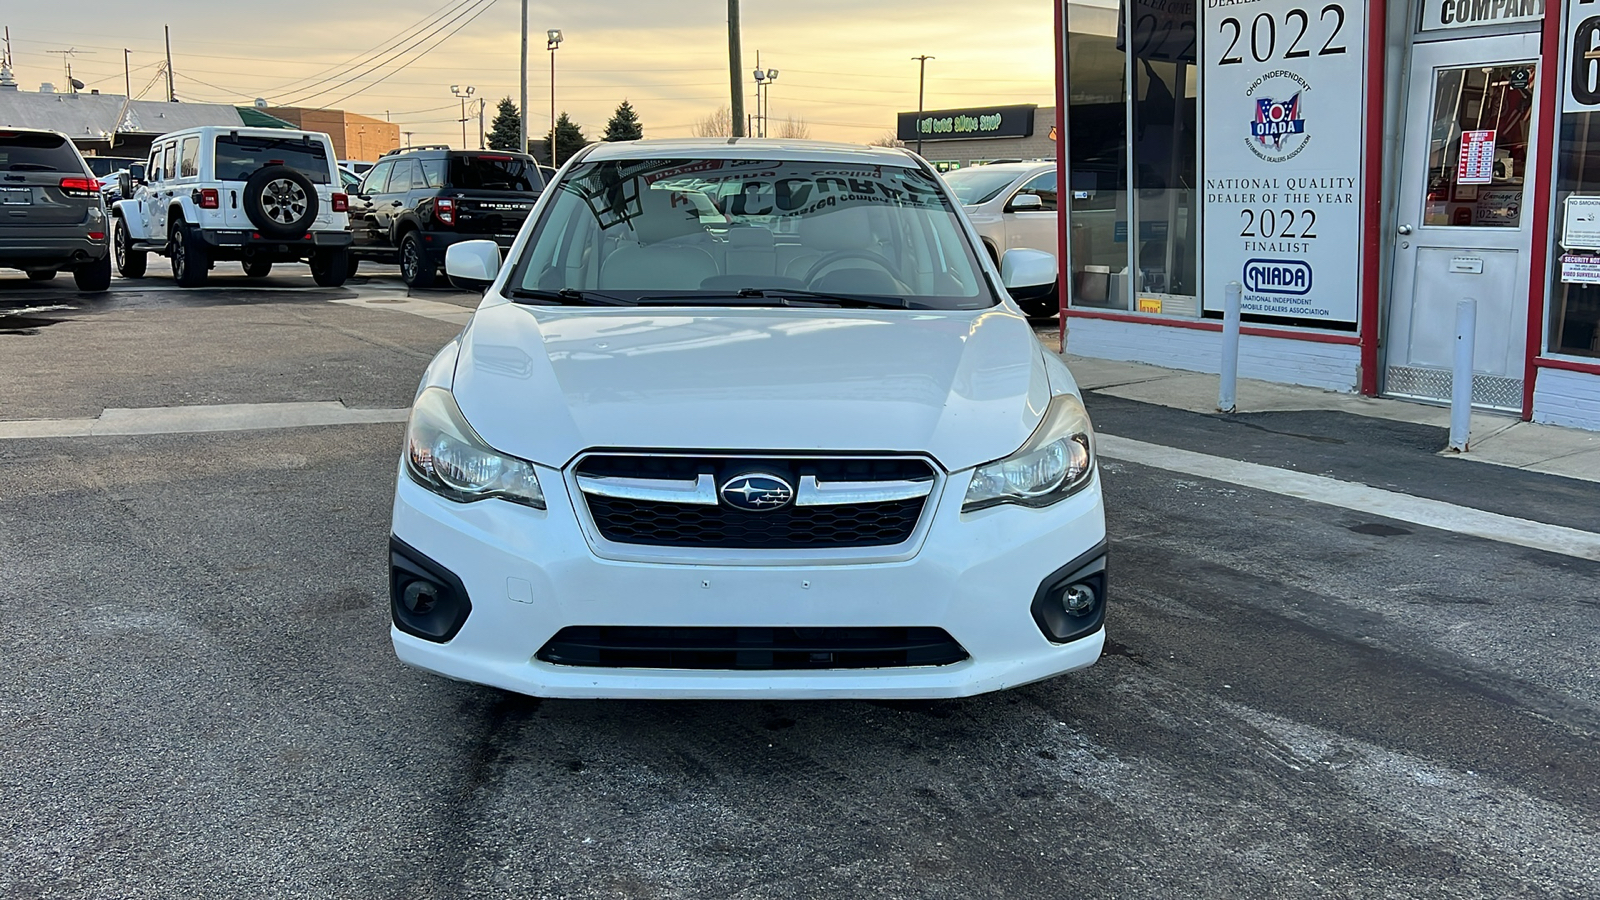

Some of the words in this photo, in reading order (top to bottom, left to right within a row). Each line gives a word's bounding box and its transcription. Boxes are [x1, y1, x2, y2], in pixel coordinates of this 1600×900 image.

[1218, 4, 1347, 65] 2022
[1246, 78, 1263, 97] OHIO
[1262, 70, 1311, 92] INDEPENDENT
[979, 112, 1002, 132] SHOP
[1256, 122, 1296, 135] OIADA
[1244, 137, 1267, 161] AUTOMOBILE
[1266, 155, 1287, 163] DEALERS
[1286, 134, 1312, 161] ASSOCIATION
[1207, 178, 1280, 190] NATIONAL
[1286, 178, 1356, 190] QUALITY
[1208, 193, 1256, 204] DEALER
[1262, 193, 1279, 204] OF
[1284, 193, 1311, 204] THE
[1317, 193, 1354, 204] YEAR
[1240, 209, 1317, 239] 2022
[1244, 241, 1310, 253] FINALIST
[1248, 266, 1306, 288] NIADA
[1244, 295, 1272, 303] NATIONAL
[1272, 297, 1312, 305] INDEPENDENT
[1264, 304, 1288, 313] DEALERS
[1289, 306, 1330, 316] ASSOCIATION
